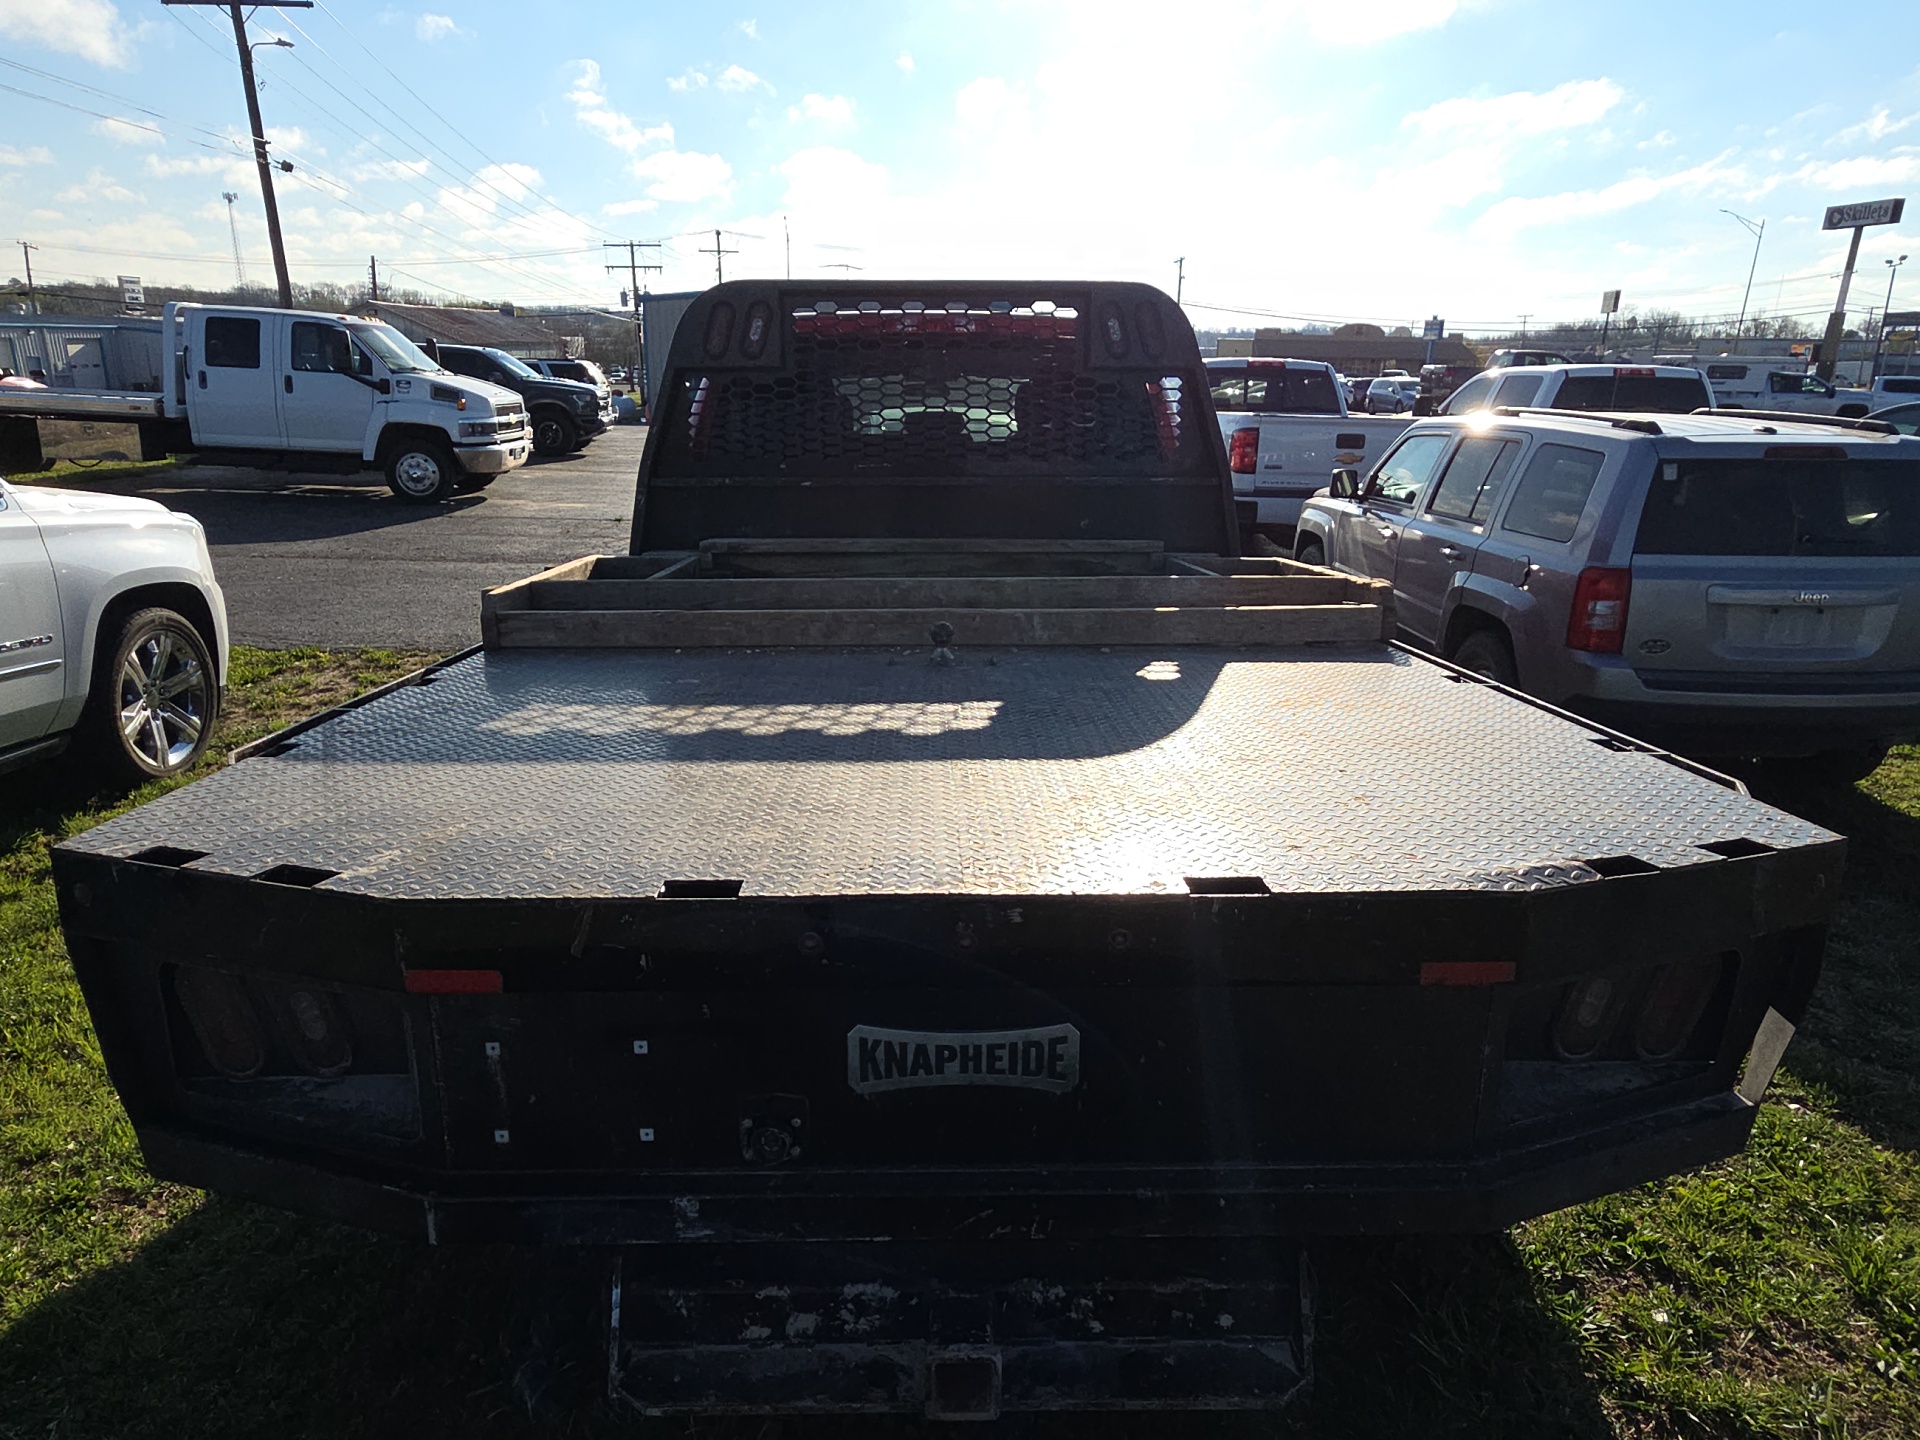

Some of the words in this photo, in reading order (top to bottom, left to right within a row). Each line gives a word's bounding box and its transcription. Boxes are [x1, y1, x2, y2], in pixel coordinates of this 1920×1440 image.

[1843, 204, 1890, 222] Skillets
[1794, 591, 1830, 605] Jeep
[858, 1035, 1069, 1083] KNAPHEIDE
